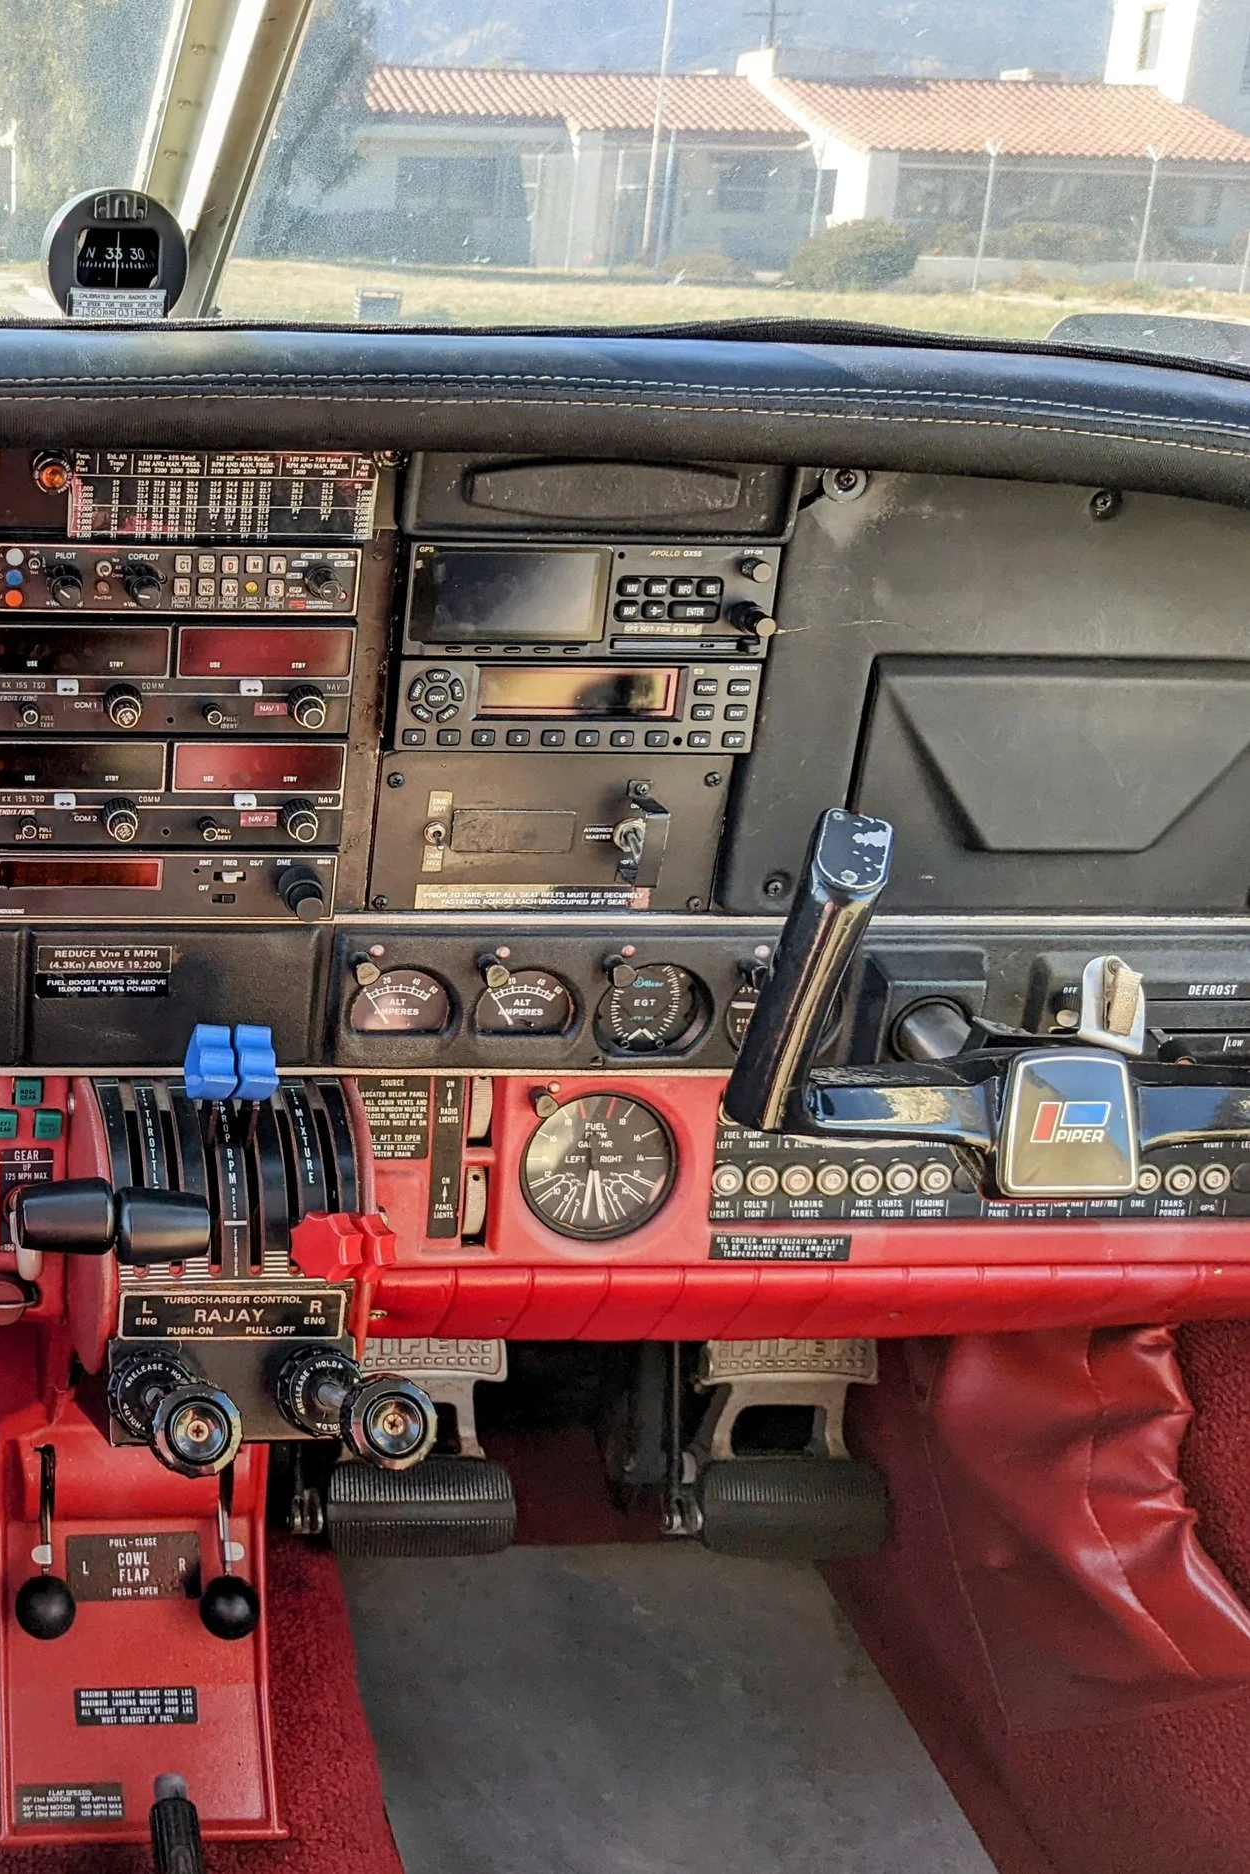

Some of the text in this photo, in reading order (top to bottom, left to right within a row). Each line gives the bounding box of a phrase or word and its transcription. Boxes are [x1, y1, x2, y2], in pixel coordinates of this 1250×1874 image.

[86, 247, 145, 260] N 33 30
[55, 552, 77, 560] PILOT
[128, 553, 160, 561] COPILOT
[626, 585, 717, 594] NAV NRST INFO SEL
[624, 607, 704, 617] MAP ENTER
[318, 796, 333, 804] NAV
[55, 950, 96, 958] REDUCE
[101, 950, 120, 958] Vne
[50, 961, 162, 970] (4.3Kn) ABOVE 19,200
[1188, 985, 1237, 995] DEFROST
[389, 998, 406, 1006] ALT
[513, 998, 531, 1006] ALT
[633, 998, 655, 1007] EGT
[374, 1008, 419, 1016] AMPERES
[498, 1008, 544, 1016] AMPERES
[1055, 1129, 1104, 1143] PIPER
[14, 1150, 39, 1161] GEAR
[600, 1155, 622, 1163] RIGHT
[163, 1295, 302, 1304] TURBOCHARGER CONTROL
[142, 1301, 152, 1314] L
[310, 1300, 322, 1313] R
[194, 1309, 265, 1322] RAJAY
[136, 1317, 158, 1325] ENG
[304, 1316, 325, 1325] ENG
[167, 1326, 296, 1335] PUSH-ON PULL-OFF
[118, 1552, 150, 1566] COWL
[119, 1568, 150, 1582] FLAP
